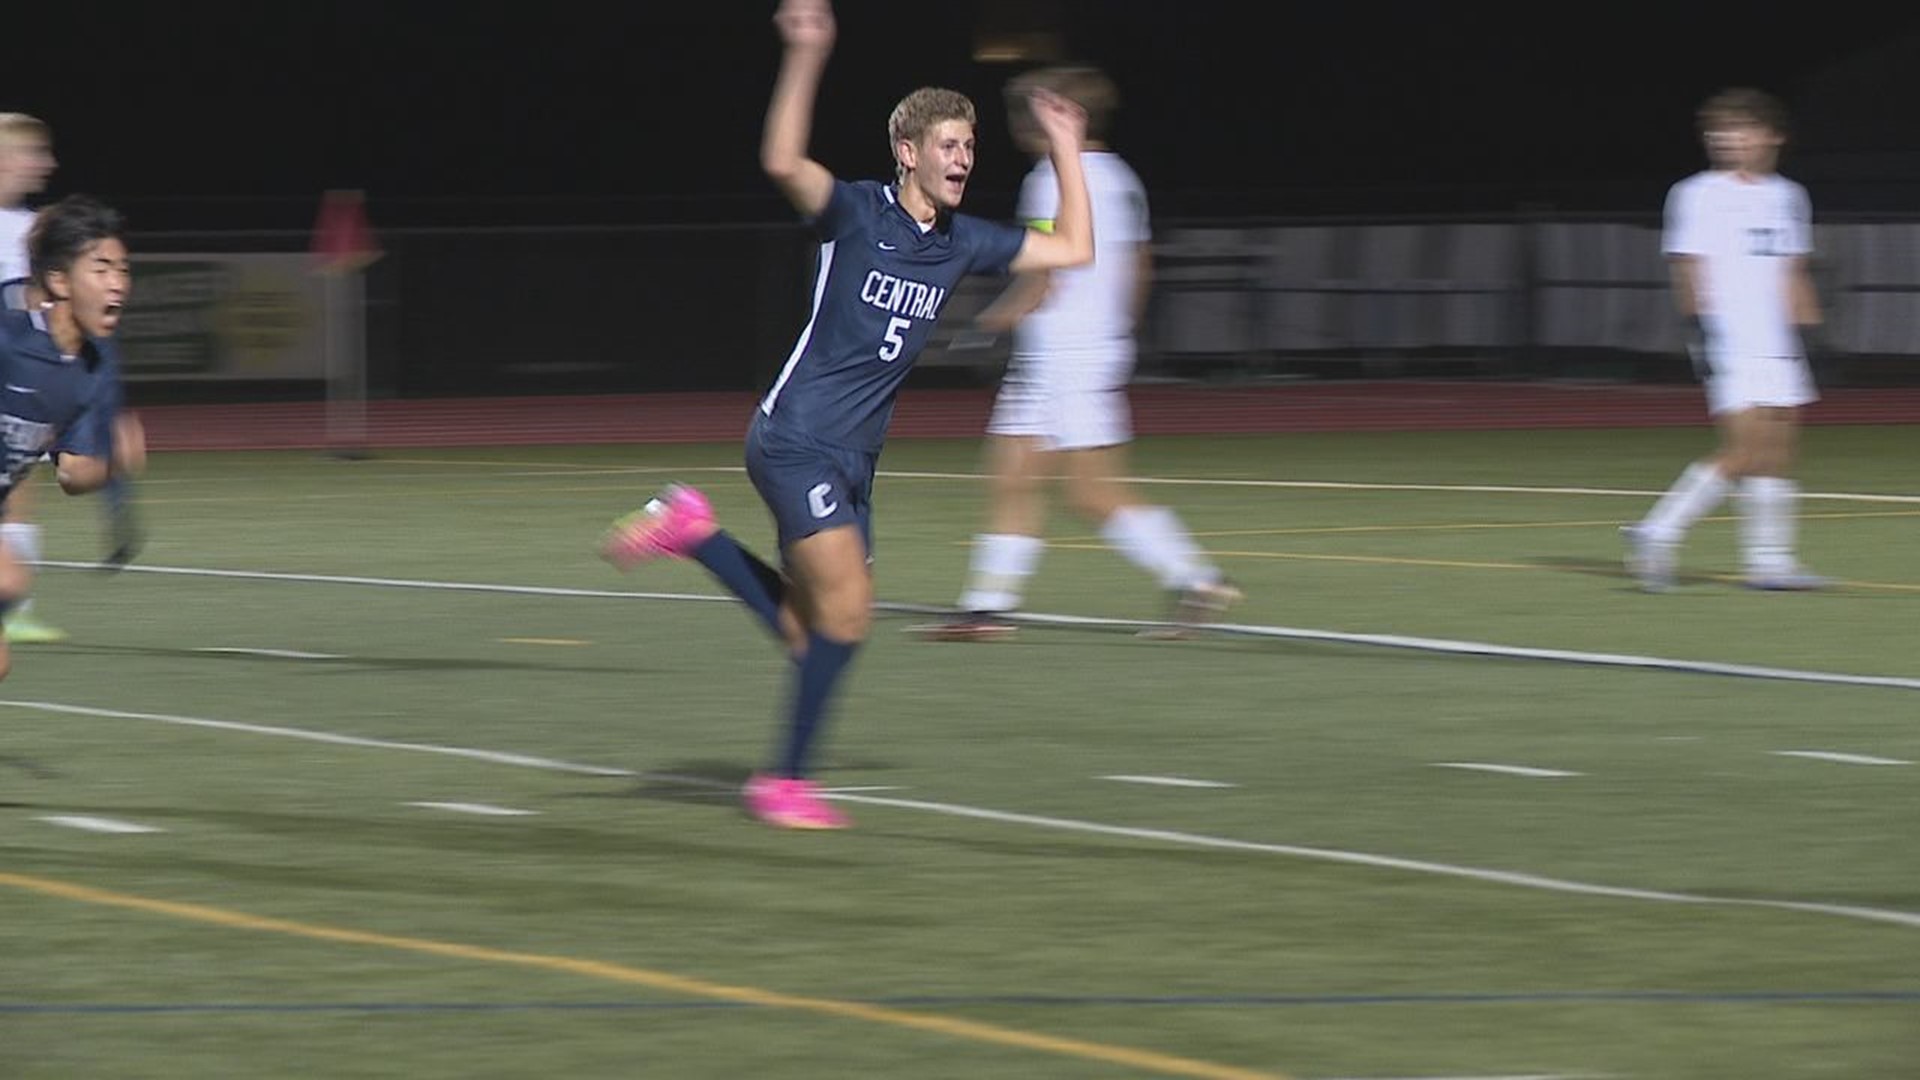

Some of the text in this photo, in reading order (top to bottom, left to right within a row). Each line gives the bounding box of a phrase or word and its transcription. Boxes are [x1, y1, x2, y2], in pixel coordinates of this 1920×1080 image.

[861, 269, 945, 320] CENTRAL
[878, 316, 911, 362] 5
[807, 482, 838, 519] C
